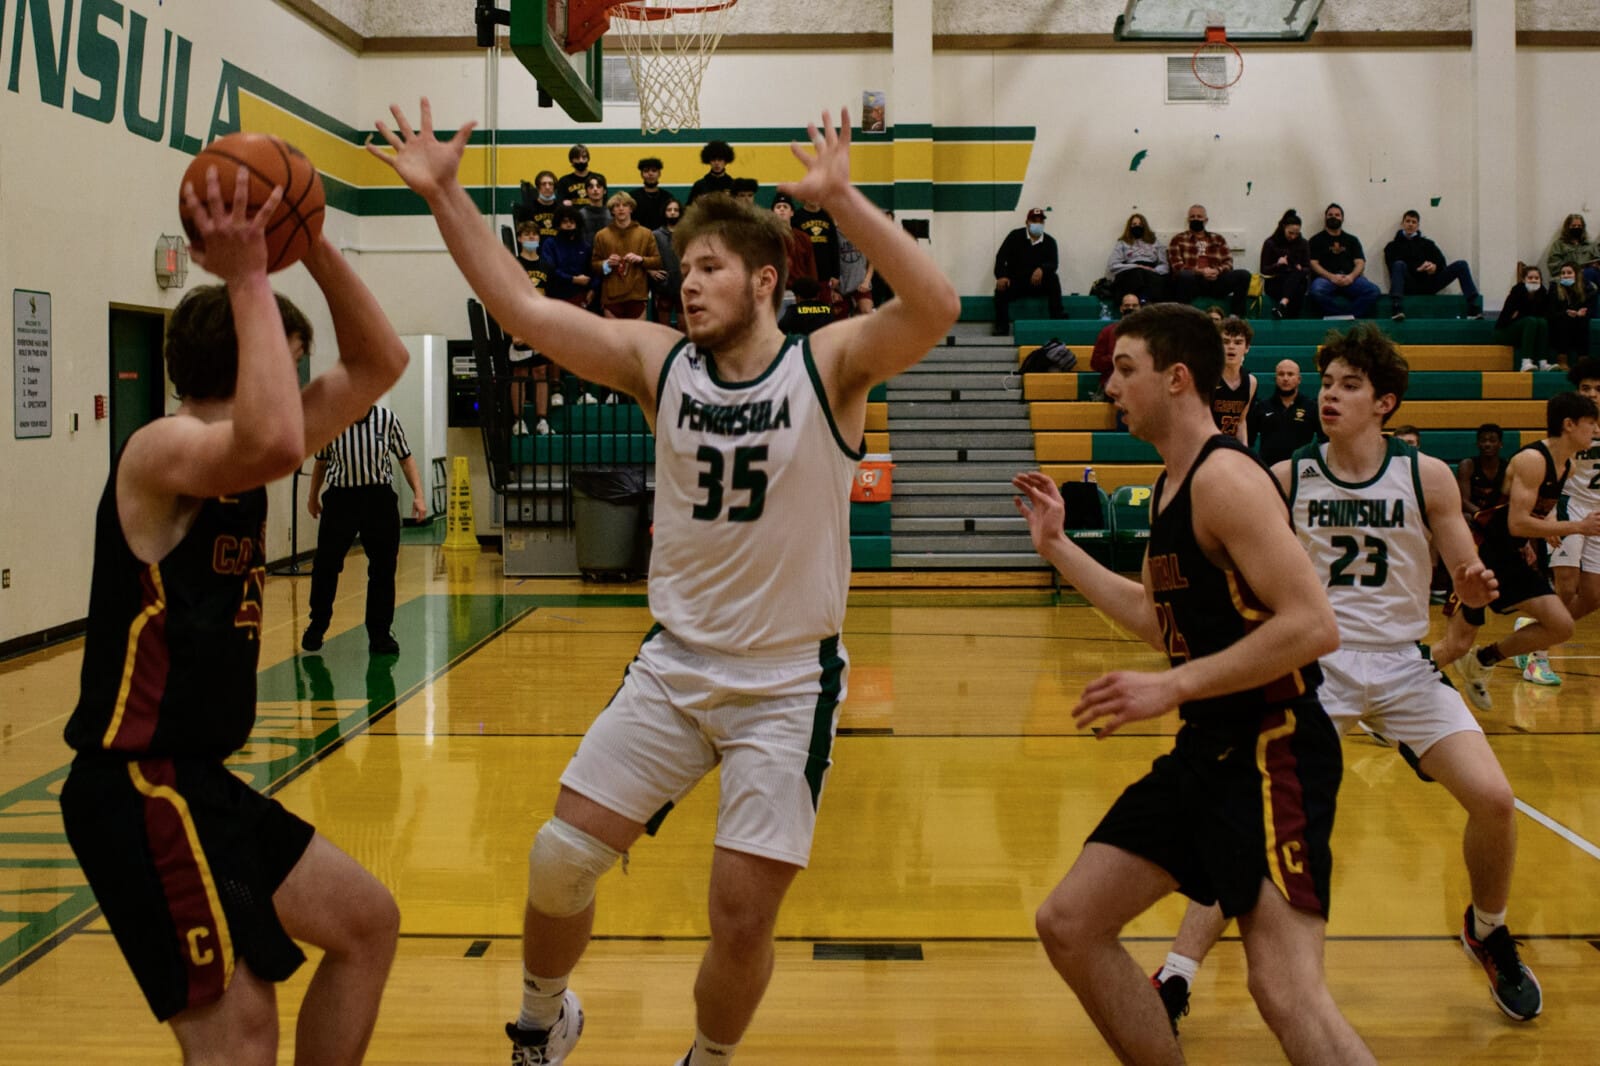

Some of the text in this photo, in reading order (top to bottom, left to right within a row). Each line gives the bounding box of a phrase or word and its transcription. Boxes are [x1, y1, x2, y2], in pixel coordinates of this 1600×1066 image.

[797, 305, 831, 315] LOYALTY
[677, 392, 791, 437] PENINSULA
[692, 445, 769, 523] 35
[1128, 487, 1151, 507] P
[1308, 499, 1404, 528] PENINSULA
[1328, 535, 1389, 588] 23
[1281, 840, 1304, 874] C
[186, 926, 215, 966] C
